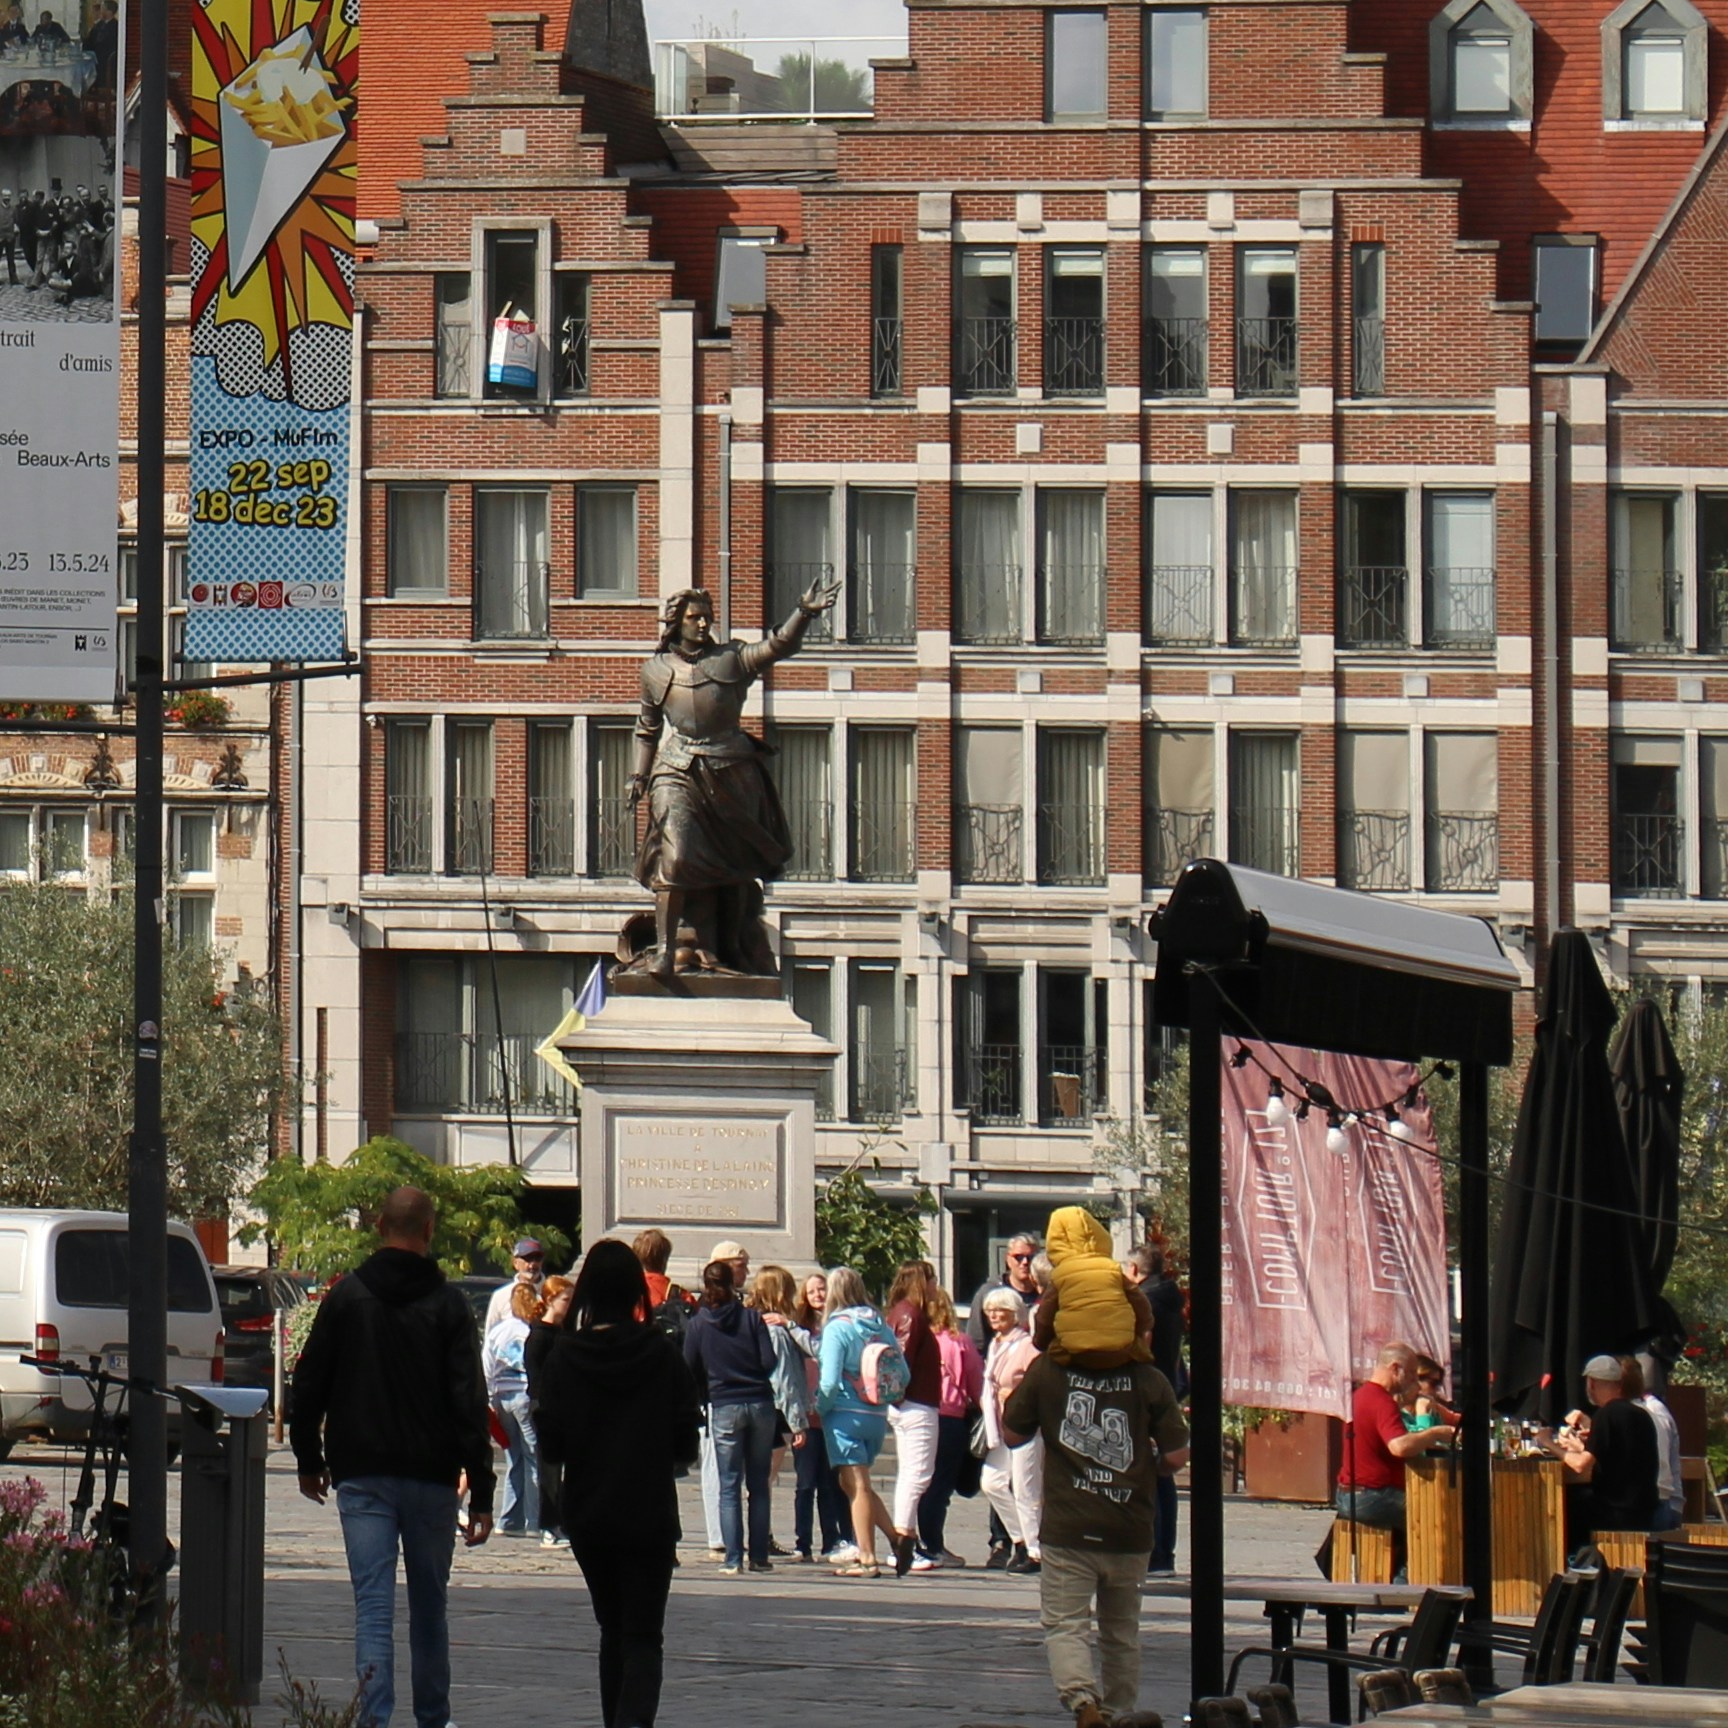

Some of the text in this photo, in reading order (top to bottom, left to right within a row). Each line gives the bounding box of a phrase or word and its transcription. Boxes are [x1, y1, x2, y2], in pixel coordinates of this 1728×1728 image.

[59, 352, 113, 372] d'amis
[200, 429, 254, 449] EXPO
[17, 449, 111, 468] Beaux-Arts
[228, 459, 332, 495] 22 sep
[194, 489, 337, 530] 18 dec 23
[49, 553, 110, 573] 13.5.24
[647, 1126, 685, 1136] VILLE
[689, 1127, 704, 1137] DE
[620, 1159, 690, 1170] CHRISTINE
[627, 1177, 699, 1189] PRINCESSE
